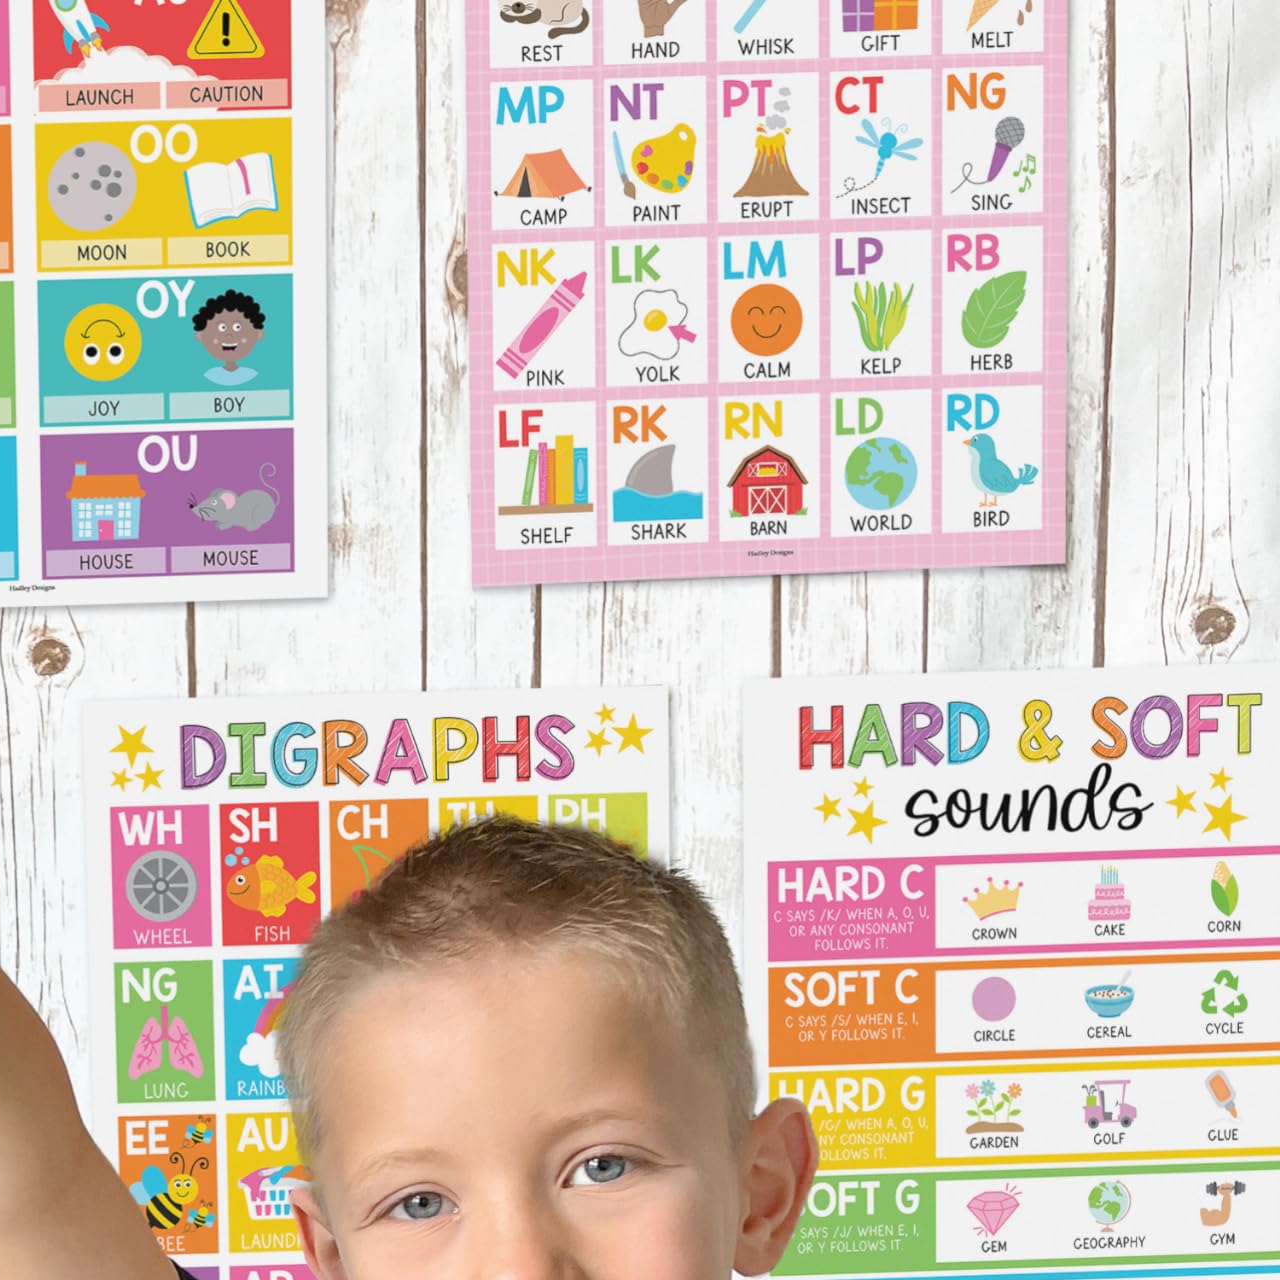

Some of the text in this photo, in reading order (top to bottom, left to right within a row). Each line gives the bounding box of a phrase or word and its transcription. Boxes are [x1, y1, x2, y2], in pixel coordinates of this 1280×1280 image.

[738, 38, 794, 55] WHISK
[861, 35, 900, 52] GIFT
[972, 31, 1013, 48] MELT
[522, 45, 563, 62] REST
[632, 42, 680, 59] HAND
[66, 89, 133, 106] LAUNCH
[190, 86, 263, 103] CAUTION
[835, 76, 884, 115] CT
[947, 72, 1006, 111] NG
[496, 85, 564, 125] MP
[130, 124, 198, 163] OO
[741, 201, 793, 218] ERUPT
[852, 197, 911, 214] INSECT
[972, 194, 1013, 211] SING
[520, 208, 567, 226] CAMP
[633, 204, 681, 222] PAINT
[78, 244, 126, 261] MOON
[206, 241, 250, 258] BOOK
[947, 233, 1000, 272] RB
[971, 353, 1012, 371] HERB
[527, 370, 564, 386] PINK
[636, 366, 679, 382] YOLK
[89, 400, 120, 416] JOY
[214, 397, 245, 413] BOY
[850, 514, 912, 532] WORLD
[974, 510, 1010, 527] BIRD
[521, 527, 573, 544] SHELF
[632, 522, 686, 540] SHARK
[751, 520, 787, 536] BARN
[80, 554, 133, 570] HOUSE
[204, 550, 258, 566] MOUSE
[799, 693, 1262, 770] HARD & SOFT
[180, 714, 576, 790] DIGRAPHS
[905, 763, 1154, 837] sounds
[118, 810, 182, 846] WH
[229, 807, 277, 843] SH
[337, 804, 388, 840] CH
[778, 864, 924, 903] HARD C
[255, 926, 290, 941] FISH
[972, 928, 1017, 940] CROWN
[1095, 923, 1125, 936] CAKE
[1208, 920, 1241, 933] CORN
[133, 928, 192, 944] WHEEL
[121, 967, 177, 1003] NG
[233, 964, 284, 1001] AI
[785, 968, 918, 1008] SOFT C
[799, 1030, 815, 1042] OR
[819, 1030, 827, 1041] Y
[832, 1028, 887, 1040] FOLLOWS
[974, 1029, 1015, 1042] CIRCLE
[1087, 1026, 1132, 1038] CEREAL
[145, 1082, 189, 1099] LUNG
[970, 1136, 1018, 1149] GARDEN
[1208, 1129, 1238, 1141] GLUE
[1073, 1236, 1145, 1250] GEOGRAPHY
[1210, 1233, 1235, 1245] GYM
